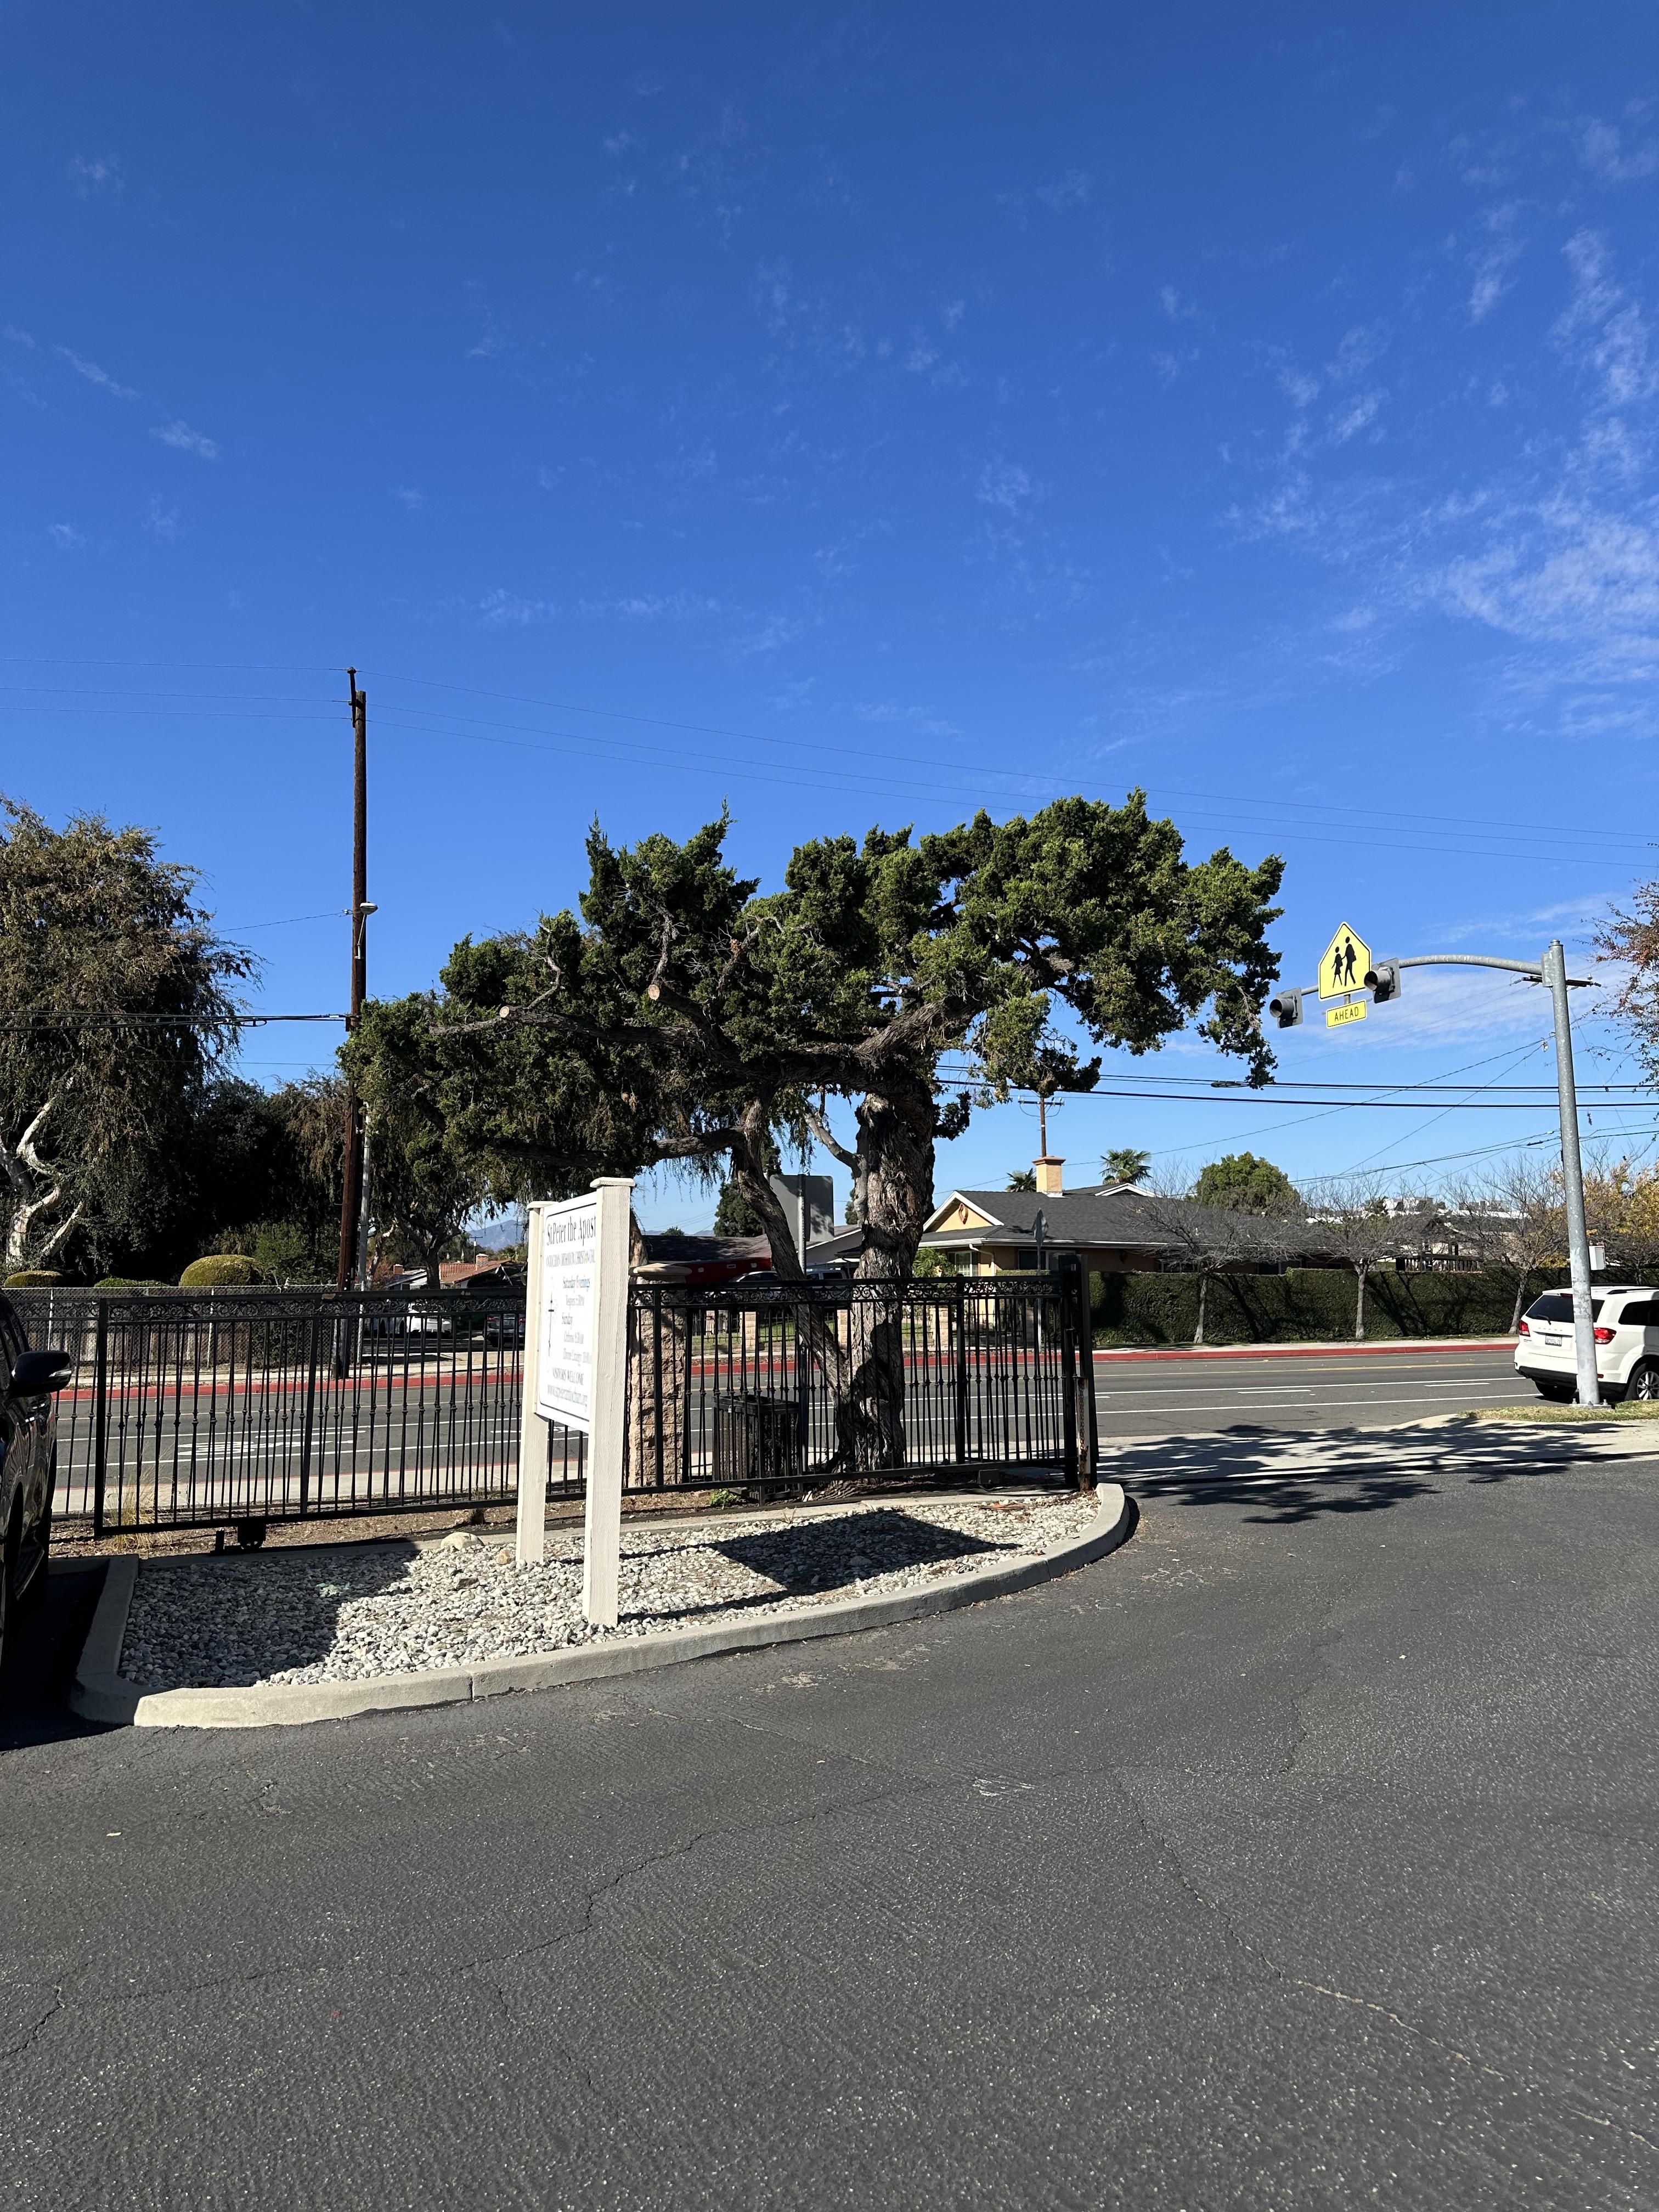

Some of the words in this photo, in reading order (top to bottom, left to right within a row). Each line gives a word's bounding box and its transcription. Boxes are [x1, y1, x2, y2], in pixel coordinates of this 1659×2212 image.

[1335, 1006, 1359, 1022] AHEAD
[568, 1216, 577, 1242] the
[567, 1370, 584, 1385] WELCOME
